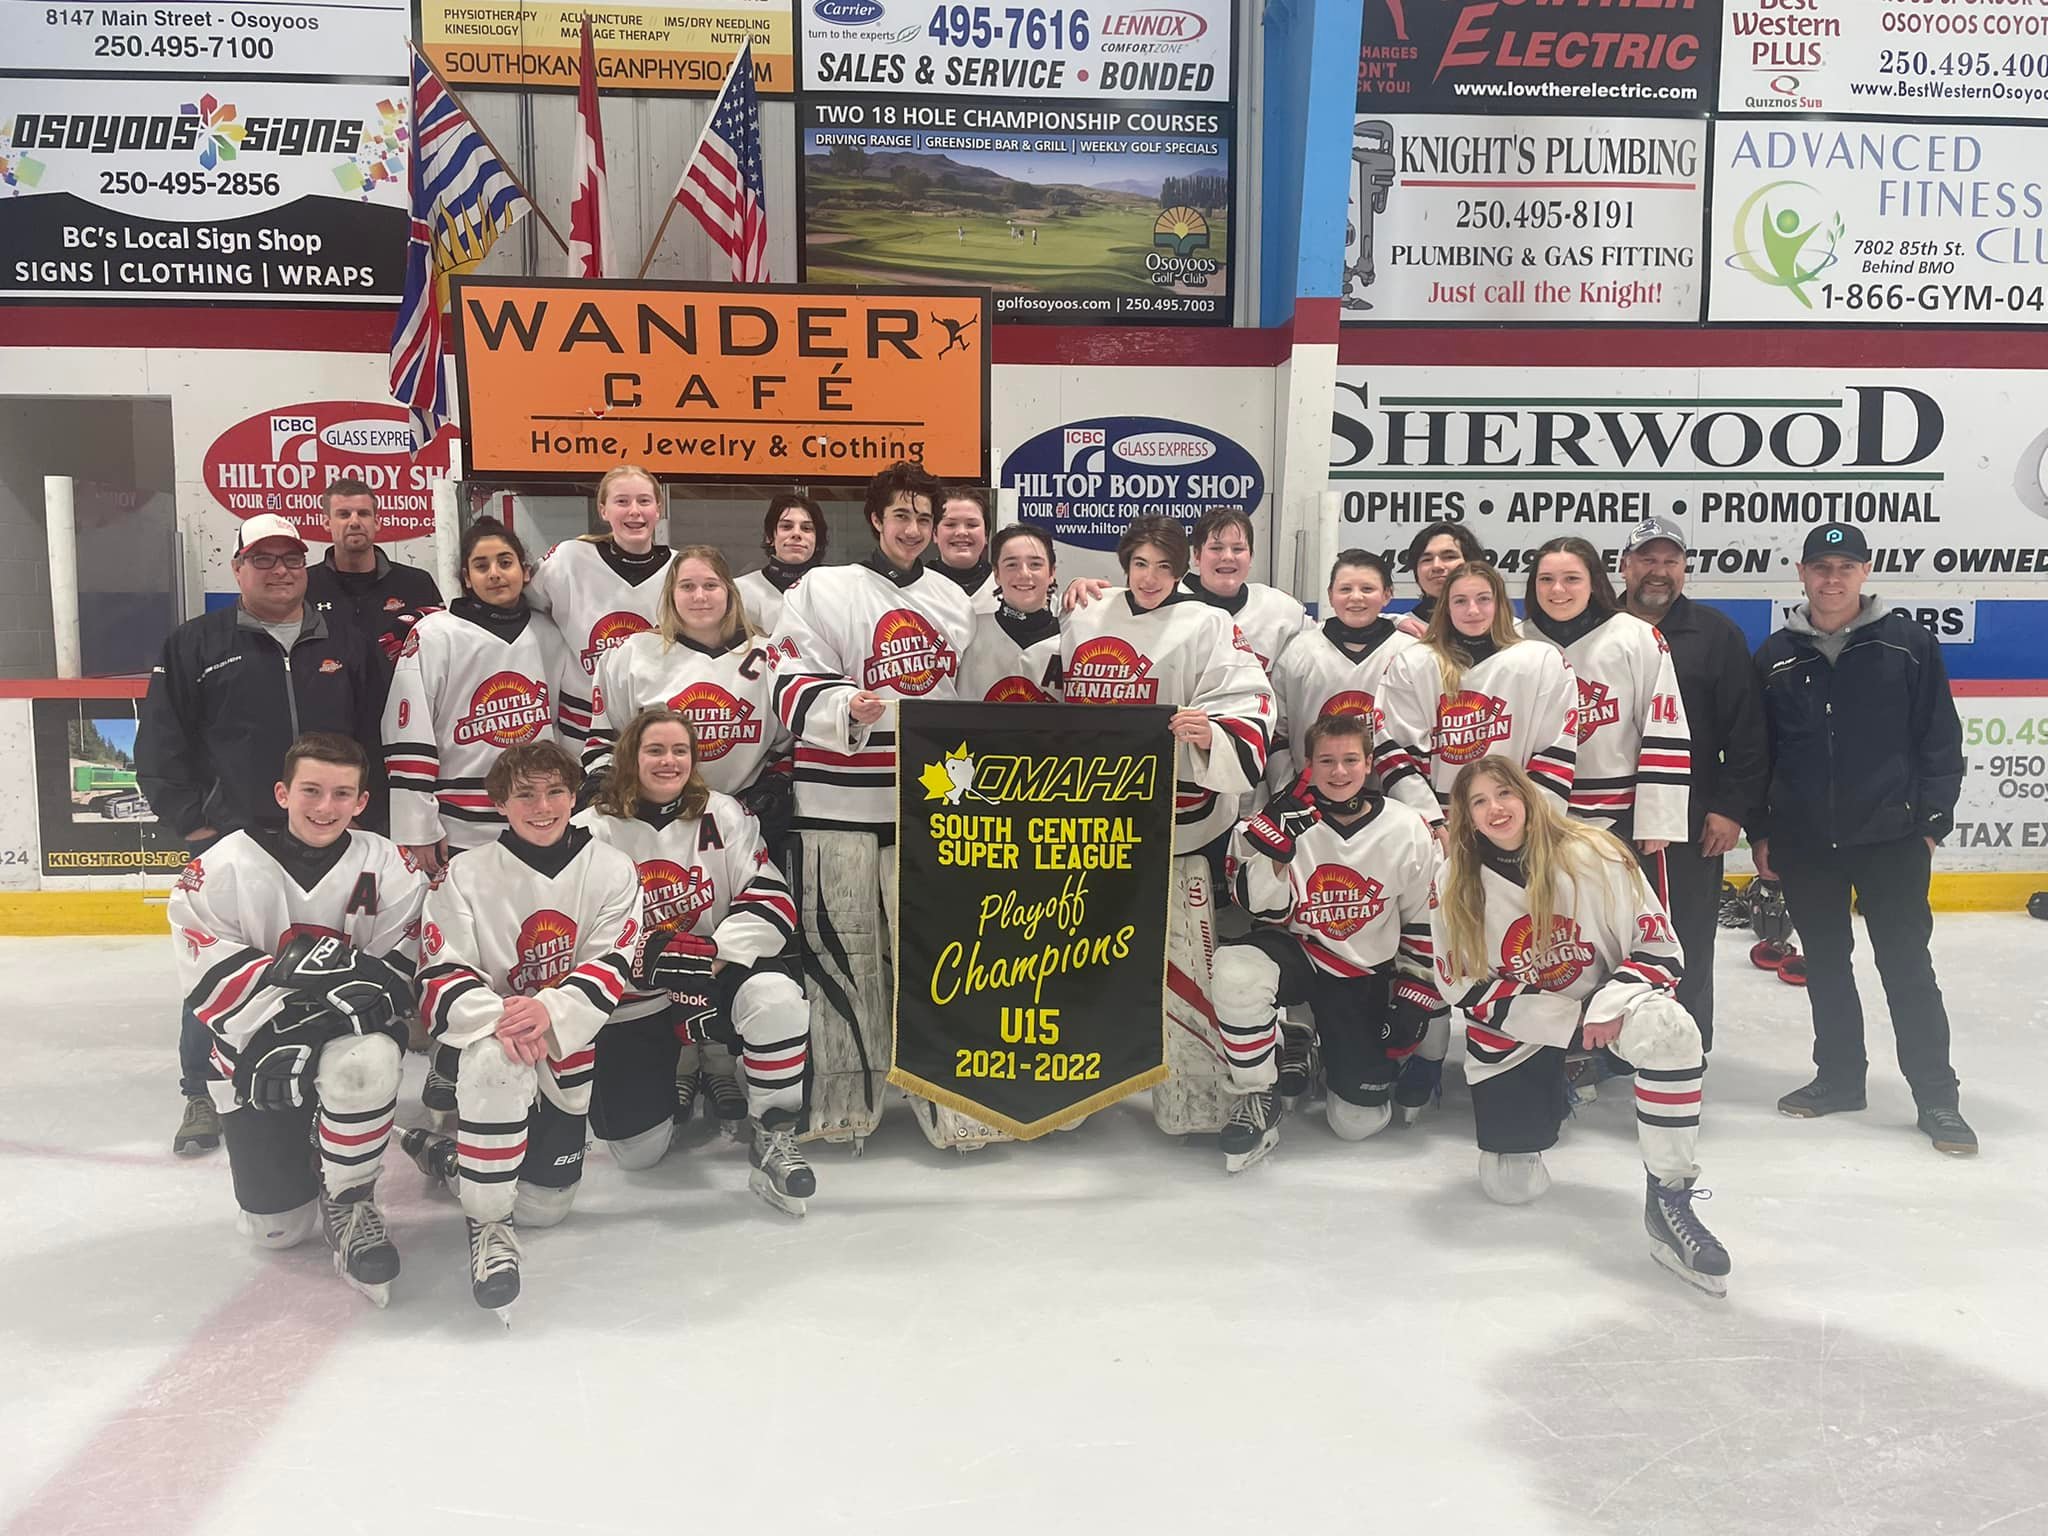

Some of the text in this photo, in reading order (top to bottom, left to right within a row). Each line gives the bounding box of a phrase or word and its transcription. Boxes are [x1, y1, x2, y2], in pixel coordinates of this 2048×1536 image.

[46, 9, 94, 26] 8147
[101, 10, 147, 27] Main
[154, 11, 212, 28] Street
[231, 12, 319, 32] Osoyoos
[444, 9, 770, 30] PHYSIOTHERAPY ACUUNCTURE IMS/DRY NEEDLING
[822, 2, 876, 18] Carrier
[445, 24, 519, 36] KINESIOLOGY
[561, 29, 616, 41] MASAGE
[619, 30, 670, 42] THERAPY
[928, 5, 1090, 51] 495-7616
[1102, 13, 1186, 38] LENNOX
[1732, 12, 1840, 36] Western
[1882, 12, 1978, 34] OSOYOOS
[94, 35, 274, 59] 250.495-7100
[808, 30, 895, 43] turn to the experts
[1432, 2, 1700, 84] ELECTRIC
[1363, 47, 1418, 60] HARGES
[1752, 41, 1822, 66] PLUS
[818, 52, 1215, 92] SALES & SERVICE BONDED
[1378, 81, 1411, 93] YOU!
[1454, 81, 1698, 99] www.lowtherelectric.com
[816, 105, 1219, 133] TWO 18 HOLE CHAMPIONSHIP COURSES
[816, 134, 1218, 155] DRIVING RANGE GREENSIDE BAR & GRILL WEEKLY GOLF SPECIALS
[1401, 134, 1697, 177] KNIGHT'S PLUMBING
[1731, 130, 1981, 172] ADVANCED
[99, 171, 280, 197] 250-495-2856
[1879, 180, 2043, 218] FITNESS
[1456, 200, 1634, 229] 250.495-8191
[63, 226, 322, 255] BC's Local Sign Shop
[1854, 240, 1965, 256] 7802 85th St.
[1146, 253, 1216, 274] Osoyoos
[1391, 245, 1695, 268] PLUMBING & GAS FITTING
[1862, 260, 1954, 274] Behind BMO
[15, 262, 375, 287] SIGNS CLOTHING WRAPS
[1152, 272, 1205, 285] Golf Club
[996, 297, 1216, 313] golfosoyoos.com 250.495.7003
[1428, 280, 1662, 309] Just call the Knight!
[466, 300, 923, 360] WANDER
[604, 363, 853, 412] CAFÉ
[273, 418, 314, 432] ICBC
[1066, 431, 1103, 444] ICBC
[1329, 382, 1944, 468] SHERWOOD
[326, 430, 411, 447] GLASS EXPRE
[531, 430, 628, 459] Home,
[642, 432, 756, 461] Jewelry
[769, 435, 788, 458] &
[1118, 441, 1209, 457] GLASS EXPRESS
[218, 464, 316, 489] HILTOP
[324, 465, 401, 490] BODY
[1014, 473, 1255, 499] HILTOP BODY SHOP
[228, 493, 264, 509] YOUR
[286, 494, 323, 510] CHOIC
[376, 494, 427, 510] OLLISION
[1022, 503, 1053, 517] YOUR
[1073, 503, 1115, 518] CHOICE
[1118, 503, 1140, 518] FOR
[1142, 504, 1201, 518] COLLISION
[1340, 491, 1940, 523] OPHIES APPAREL PROMOTIONAL
[739, 648, 767, 681] C
[1072, 661, 1131, 679] SOUTH
[1063, 682, 1151, 700] KANAGAN
[399, 699, 410, 729] 9
[475, 692, 531, 717] SOUTH
[1651, 694, 1678, 723] 14
[967, 755, 1158, 803] OMAHA
[1990, 756, 2045, 777] 9150
[698, 813, 724, 852] A
[930, 813, 1142, 843] SOUTH CENTRAL
[1956, 823, 2014, 847] TAX
[937, 840, 1132, 870] SUPER LEAGUE
[346, 872, 377, 915] A
[643, 882, 685, 906] OUTH
[978, 871, 1088, 940] Playoff
[930, 925, 1135, 1005] Champions
[1000, 1007, 1060, 1045] U15
[955, 1049, 1101, 1081] 2021-2022
